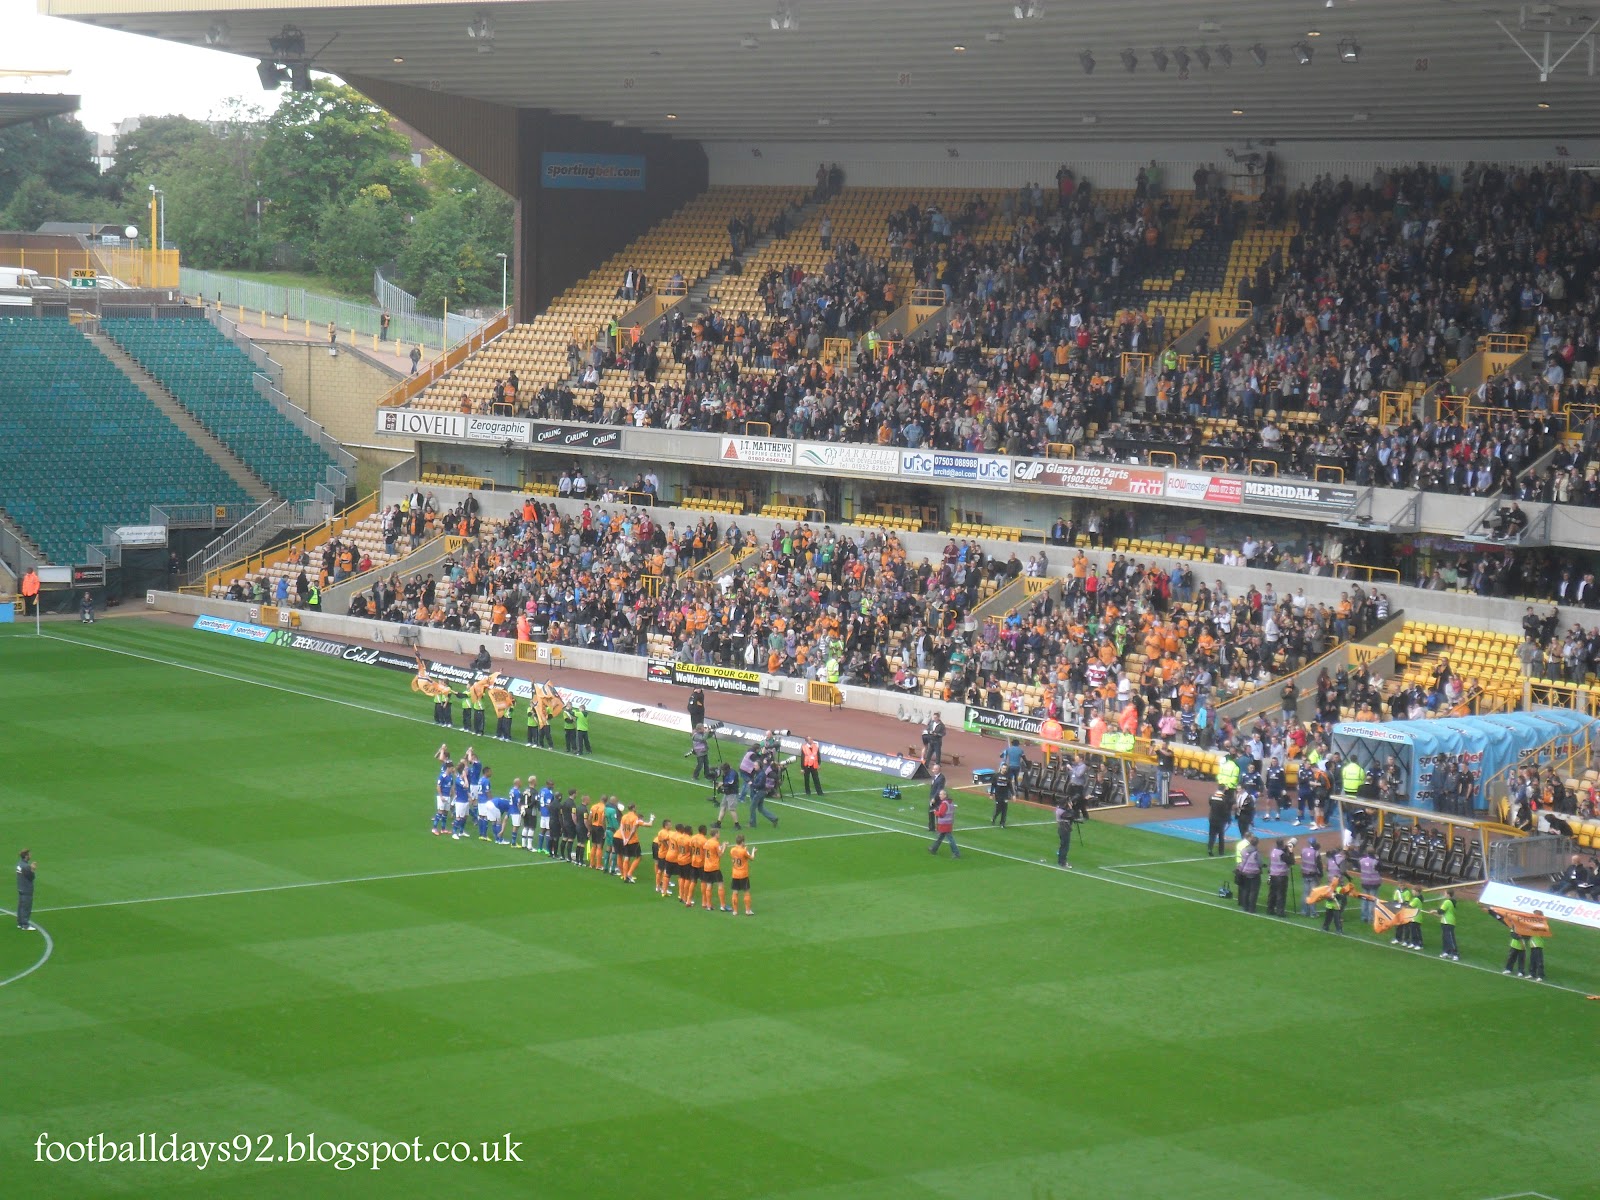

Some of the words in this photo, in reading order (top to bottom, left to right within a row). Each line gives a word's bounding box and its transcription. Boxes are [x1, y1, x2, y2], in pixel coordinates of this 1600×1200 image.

[547, 163, 641, 179] sportingbet.com
[89, 270, 95, 278] 2
[402, 414, 460, 437] LOVELL
[470, 419, 525, 434] Zerographic
[537, 428, 562, 442] CARLING
[564, 430, 589, 444] CARLING
[592, 432, 617, 446] CARLING
[752, 441, 792, 453] MATTHEWS
[838, 448, 897, 461] PARKHILL
[934, 456, 954, 467] 07503
[857, 458, 894, 466] DEVELOPMENT
[903, 454, 932, 472] URC
[979, 460, 1009, 478] URC
[1045, 463, 1075, 475] Glaze
[1075, 466, 1101, 477] Auto
[1102, 467, 1129, 480] Parts
[1061, 474, 1086, 484] 01902
[1245, 482, 1320, 500] MERRIDALE
[198, 619, 231, 631] sportingbet
[235, 625, 267, 638] sportingbet
[430, 662, 475, 679] Wombourne
[474, 671, 510, 686] Tanori
[676, 663, 710, 674] SELLING
[713, 668, 736, 678] YOUR
[737, 671, 759, 680] CAR?
[675, 672, 760, 694] WeWantAnyVehicle.com
[797, 684, 804, 693] 31
[1343, 724, 1405, 742] sportingbet.com
